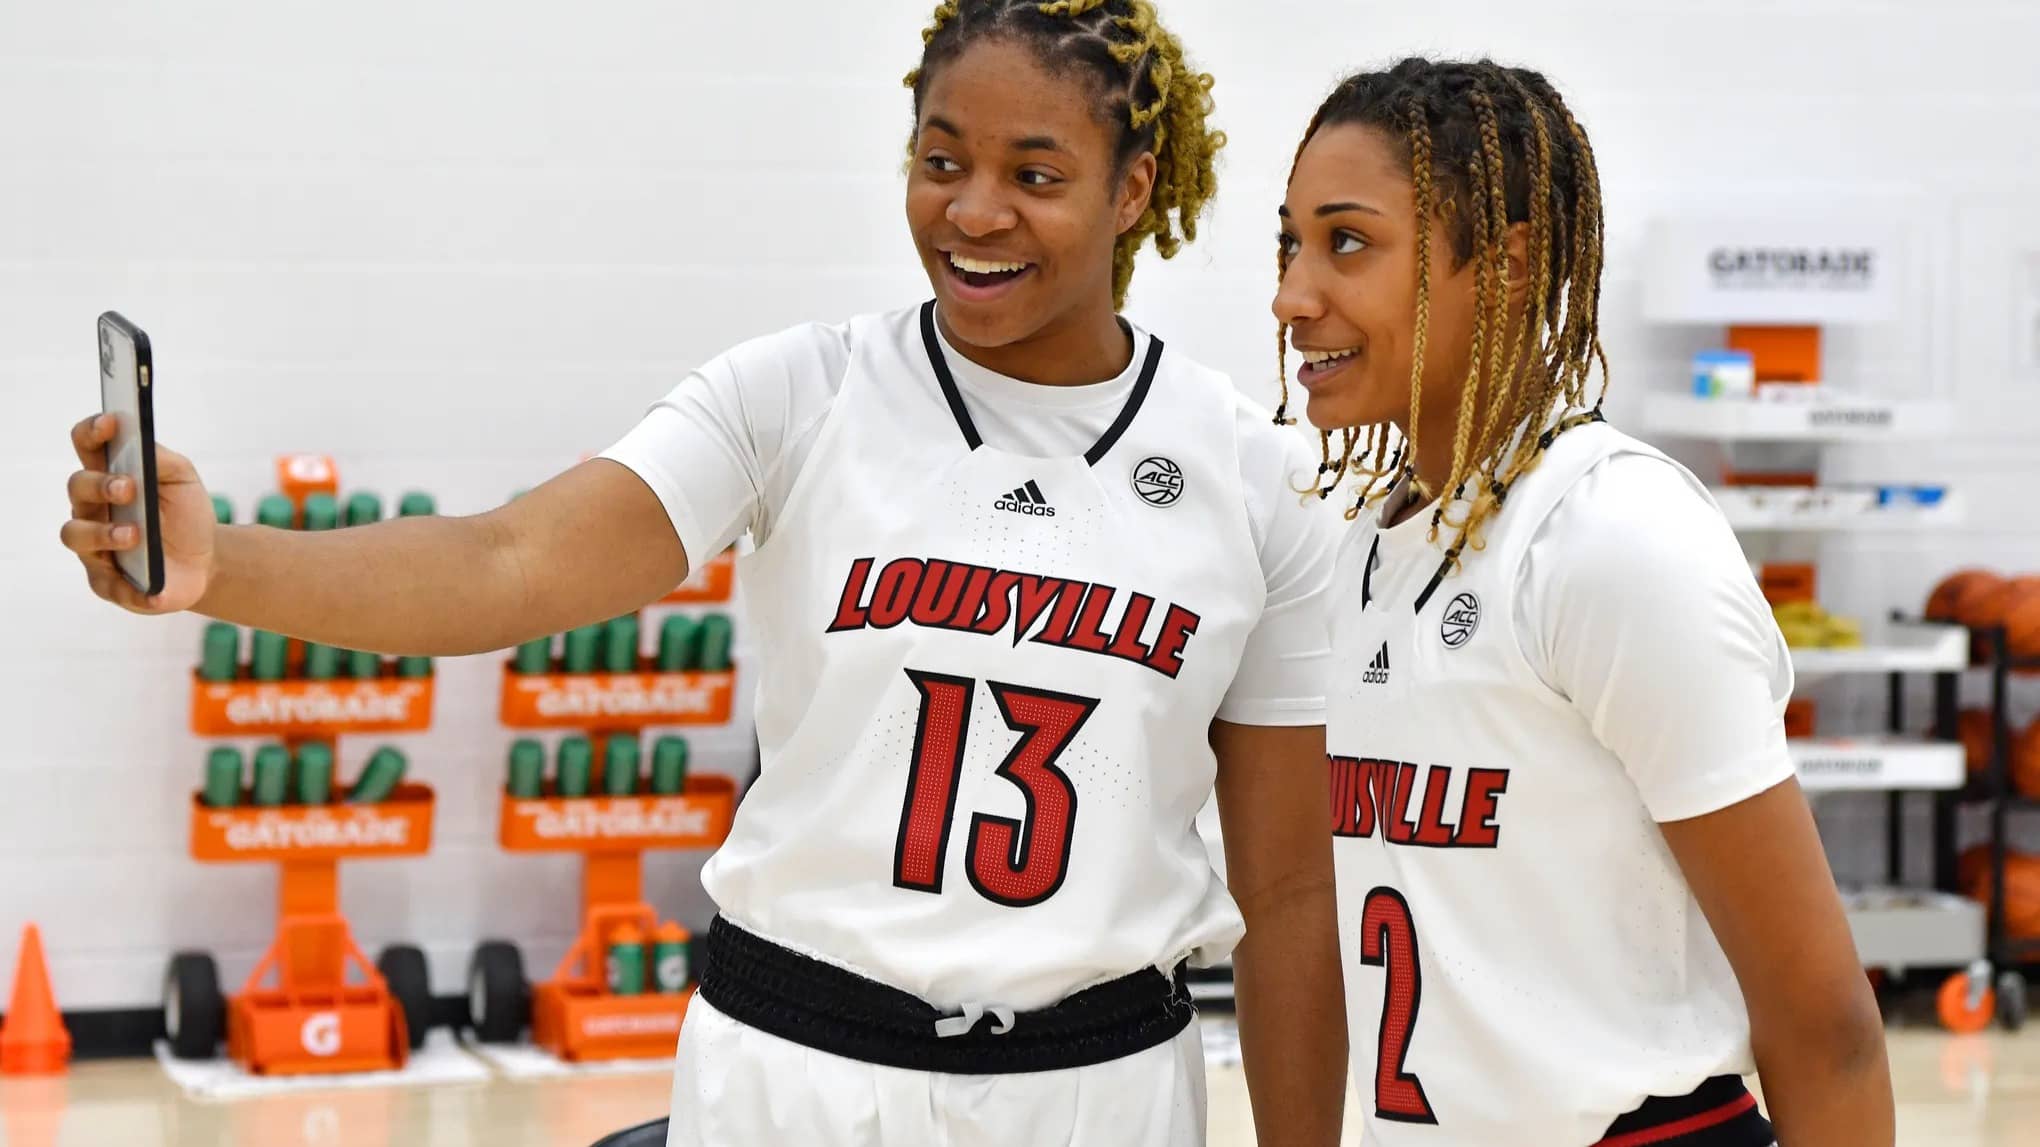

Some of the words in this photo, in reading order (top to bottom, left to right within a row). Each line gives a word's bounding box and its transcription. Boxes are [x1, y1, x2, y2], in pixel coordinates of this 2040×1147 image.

[1708, 248, 1875, 277] GATORADE
[1139, 471, 1182, 488] ACC
[993, 499, 1056, 517] adidas
[825, 557, 1202, 680] LOUISVILLE
[1446, 609, 1477, 625] ACC
[226, 693, 411, 725] GATORADE
[536, 690, 714, 718] GATORADE
[892, 667, 1102, 908] 13
[1327, 754, 1510, 848] UISVILLE
[225, 815, 410, 850] GATORADE
[534, 809, 710, 839] GATORADE
[1360, 886, 1440, 1126] 2
[302, 1010, 342, 1056] G
